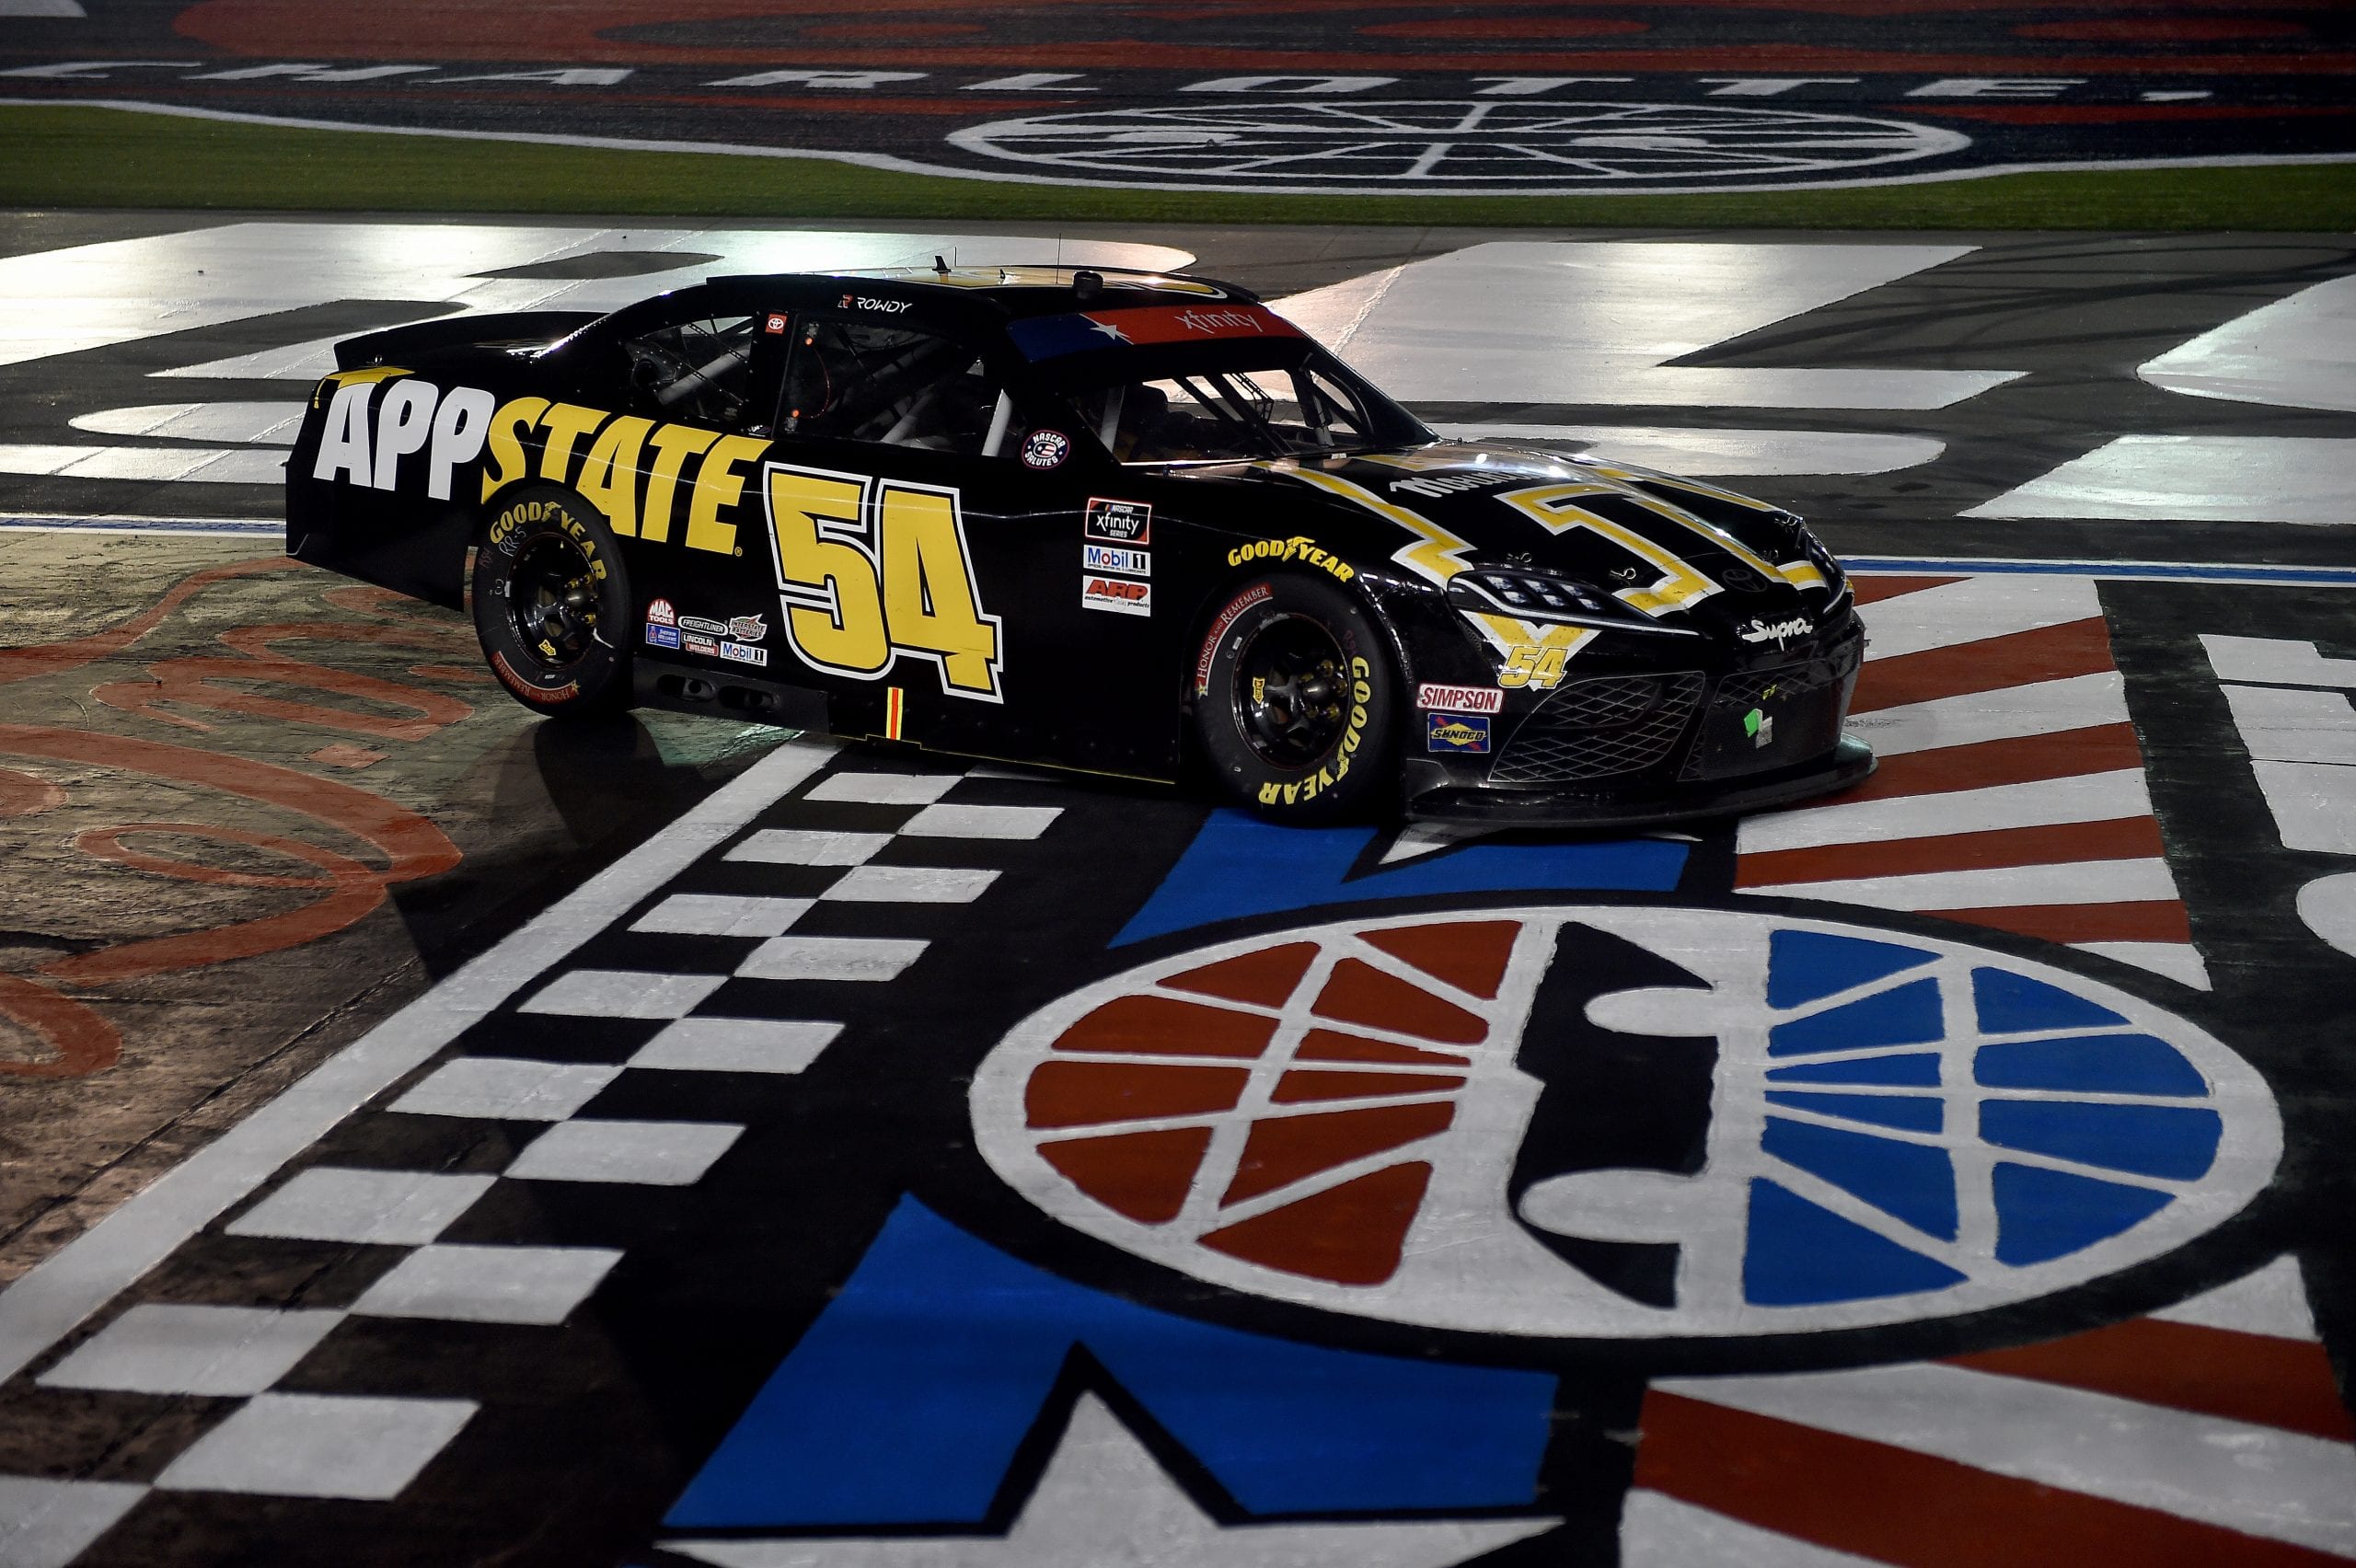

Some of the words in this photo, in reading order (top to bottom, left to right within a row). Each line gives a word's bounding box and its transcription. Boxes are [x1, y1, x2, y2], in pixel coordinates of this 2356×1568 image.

[857, 296, 913, 313] ROWDY
[1174, 309, 1264, 334] xfinity
[1033, 432, 1066, 449] NASCAR
[1024, 451, 1058, 467] SALUTES
[1112, 504, 1134, 513] NASCAR
[1096, 513, 1139, 536] xfinity
[1109, 529, 1127, 538] SERIES
[490, 502, 607, 580] GOODYEAR
[1088, 548, 1128, 568] Mobil
[1228, 536, 1355, 582] GOODYEAR
[764, 461, 1003, 704] 54
[1086, 580, 1149, 600] ARP
[650, 600, 674, 617] MAC
[650, 615, 674, 625] TOOLS
[682, 618, 724, 633] FREIGHTLINER
[683, 634, 712, 646] LINCOLN
[1197, 635, 1217, 678] HONOR
[1220, 587, 1268, 624] REMEMBER
[1742, 617, 1813, 651] Supra
[688, 644, 715, 654] WELDERS
[723, 643, 752, 660] Mobil
[1497, 644, 1568, 689] 54
[1422, 686, 1497, 710] SIMPSON
[1258, 656, 1371, 805] GOODYEAR
[1433, 729, 1487, 741] SUNOCO
